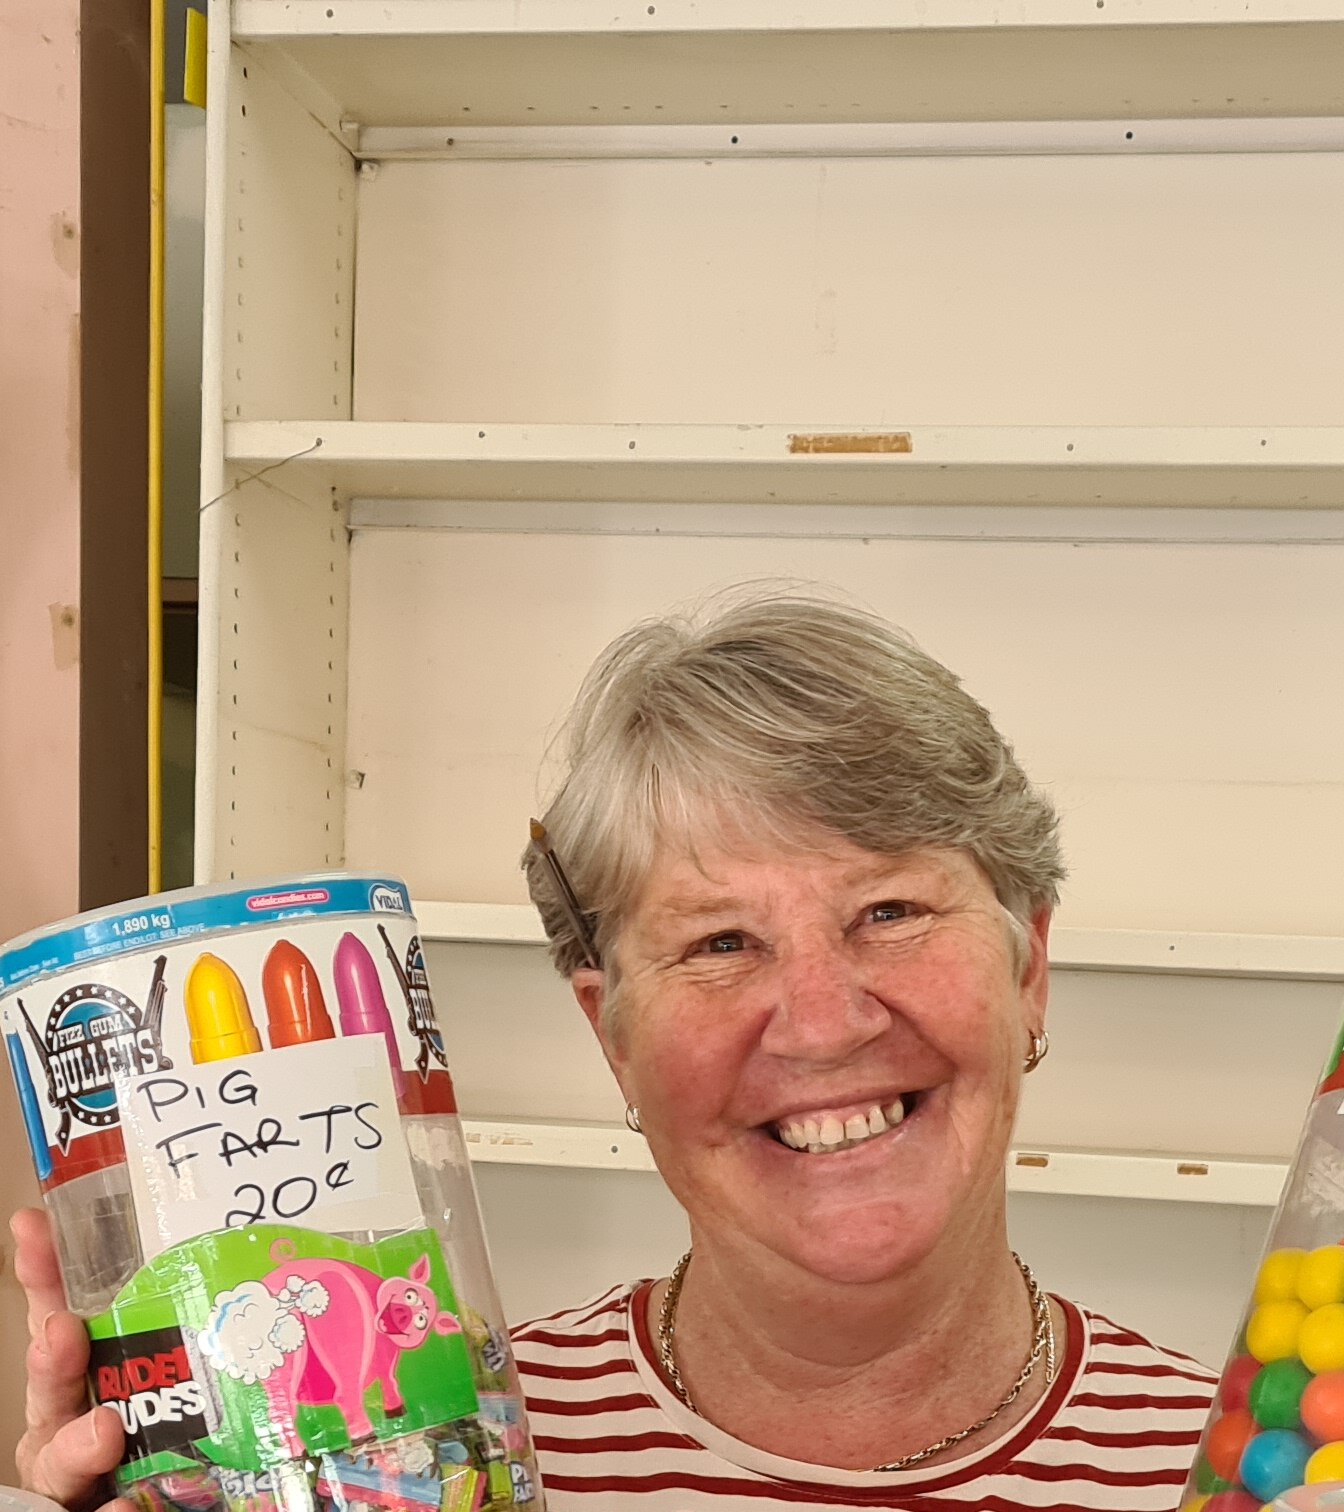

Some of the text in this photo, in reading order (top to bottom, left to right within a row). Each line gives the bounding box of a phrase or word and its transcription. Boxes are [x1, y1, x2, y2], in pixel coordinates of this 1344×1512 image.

[112, 912, 171, 936] 1,890 kg
[58, 1012, 124, 1048] FIZZ GUM
[48, 1028, 159, 1100] BULLETS
[136, 1069, 259, 1122] PIG
[155, 1102, 383, 1179] FARTS
